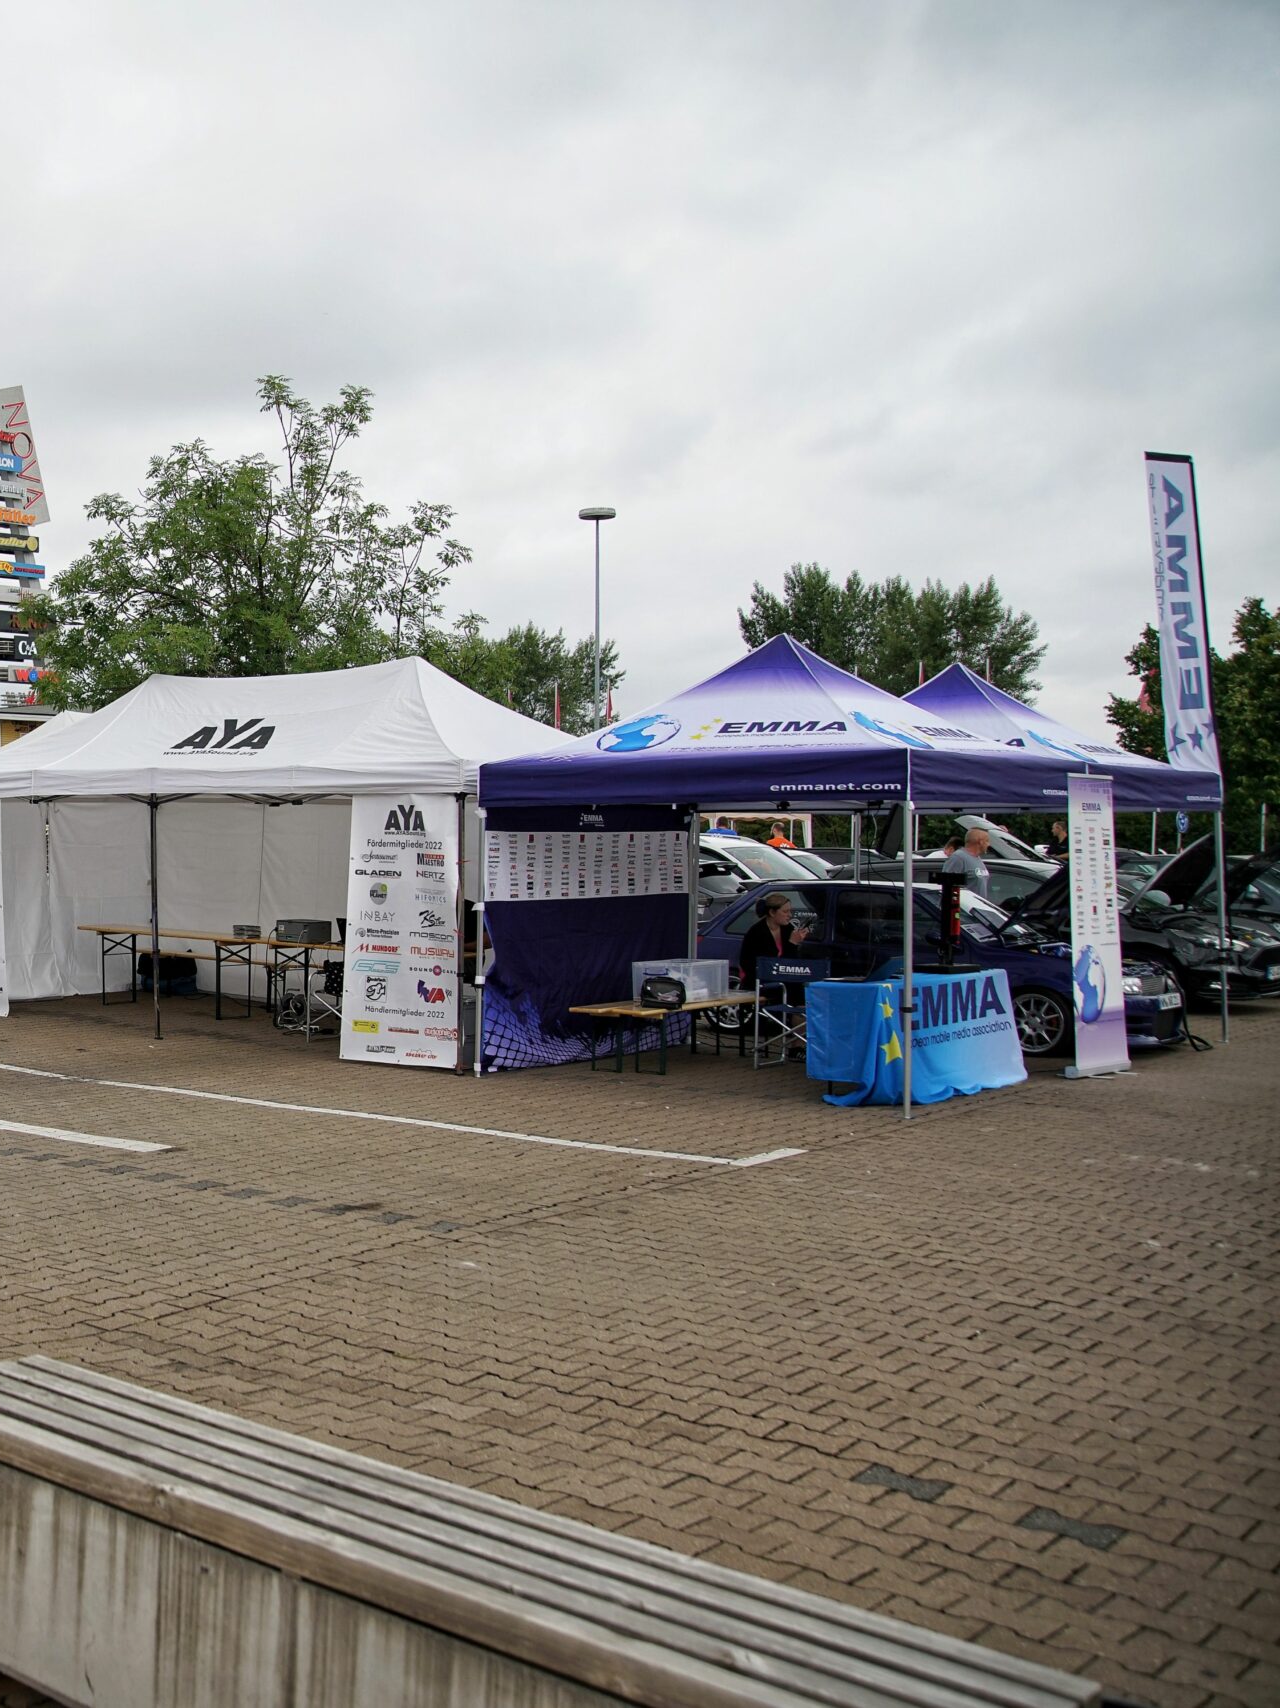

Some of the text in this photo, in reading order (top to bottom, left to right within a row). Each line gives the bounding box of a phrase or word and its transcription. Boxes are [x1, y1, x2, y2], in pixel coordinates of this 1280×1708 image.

[1, 401, 44, 510] NOVA
[18, 640, 38, 655] C&A
[169, 717, 276, 749] AYA
[718, 720, 848, 734] EMMA
[770, 782, 902, 792] emmanet.com
[1081, 802, 1102, 811] EMMA
[384, 804, 426, 832] AYA
[583, 814, 604, 822] EMMA
[367, 838, 443, 850] Fördermitglieder 2022
[417, 853, 445, 867] MAESTRO
[355, 869, 402, 877] GLADEN
[416, 870, 445, 880] HERTZ
[360, 910, 396, 922] INBAY
[410, 946, 455, 958] MUSWAY
[779, 965, 812, 974] EMMA
[899, 975, 1007, 1033] EMMA
[365, 1005, 445, 1019] Händlermitglieder 2022
[931, 1030, 950, 1044] mobile
[952, 1027, 971, 1040] media
[972, 1020, 1012, 1036] association
